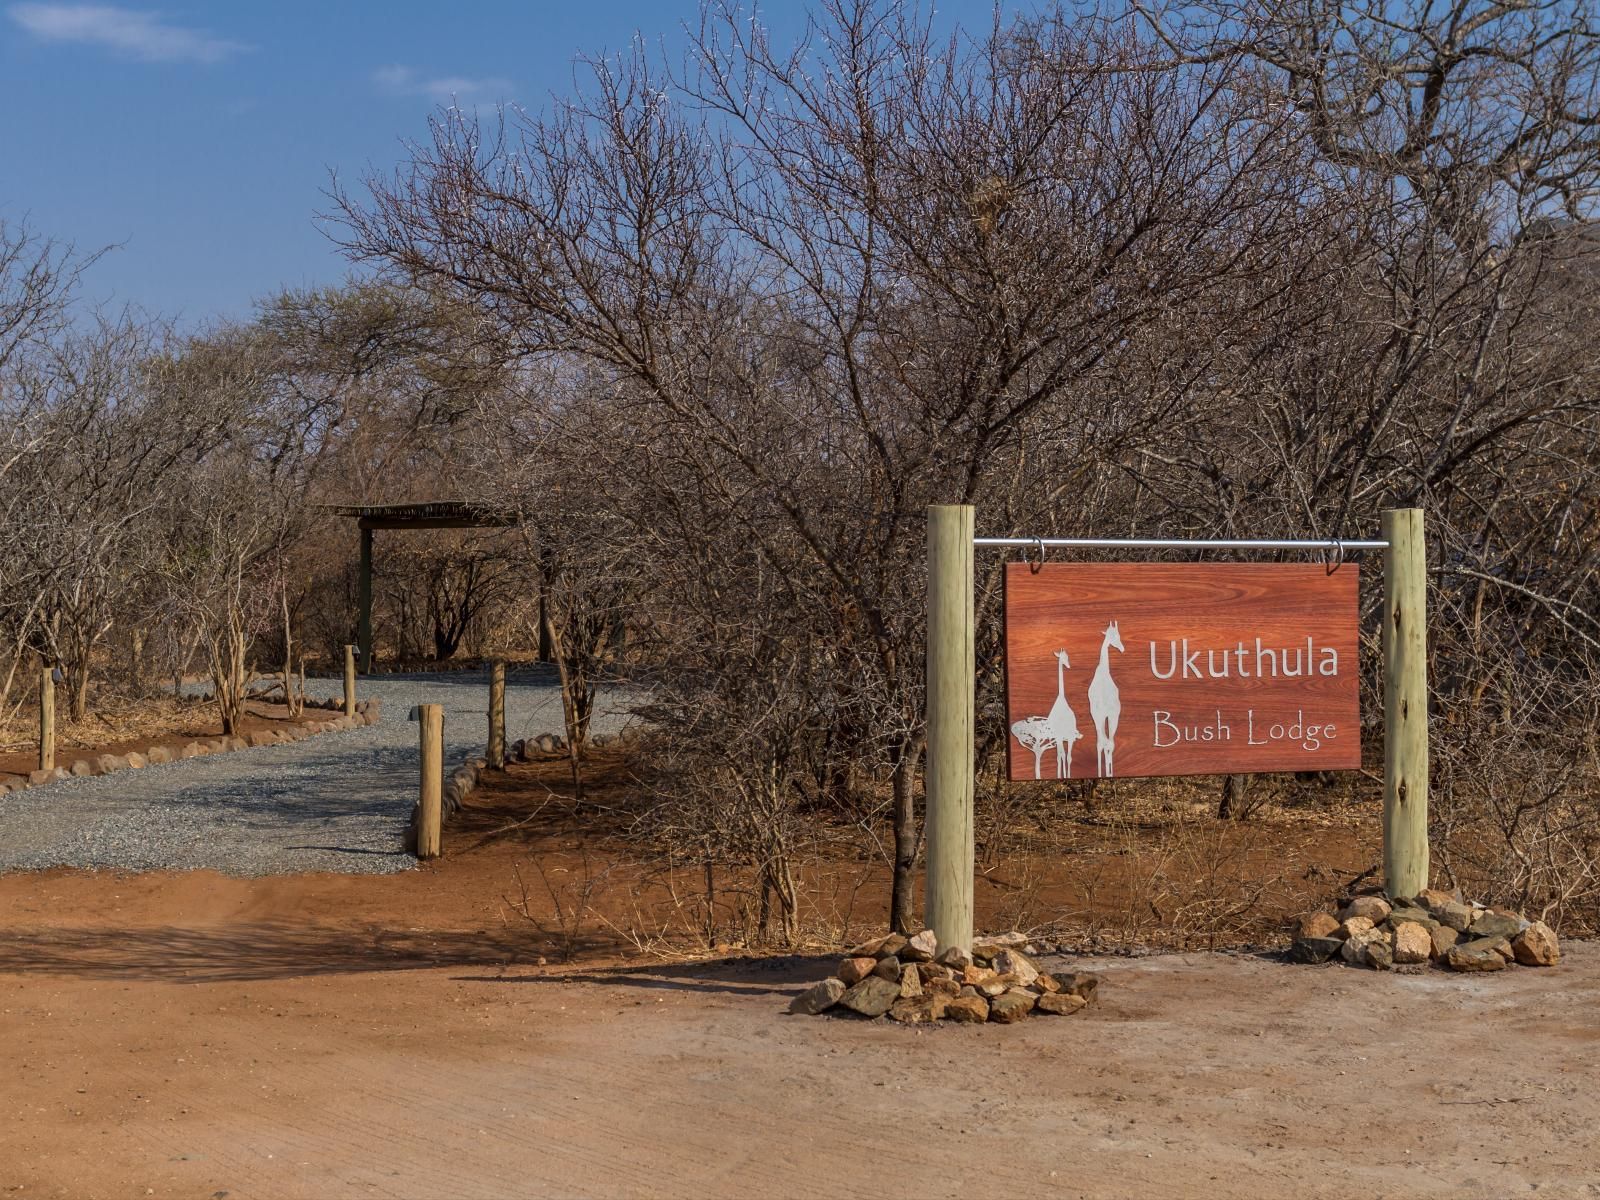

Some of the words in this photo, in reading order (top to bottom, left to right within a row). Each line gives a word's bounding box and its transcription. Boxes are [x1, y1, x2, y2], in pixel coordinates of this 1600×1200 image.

[1150, 636, 1338, 679] Ukuthula
[1153, 709, 1231, 747] Bush
[1247, 709, 1337, 751] Lodge
